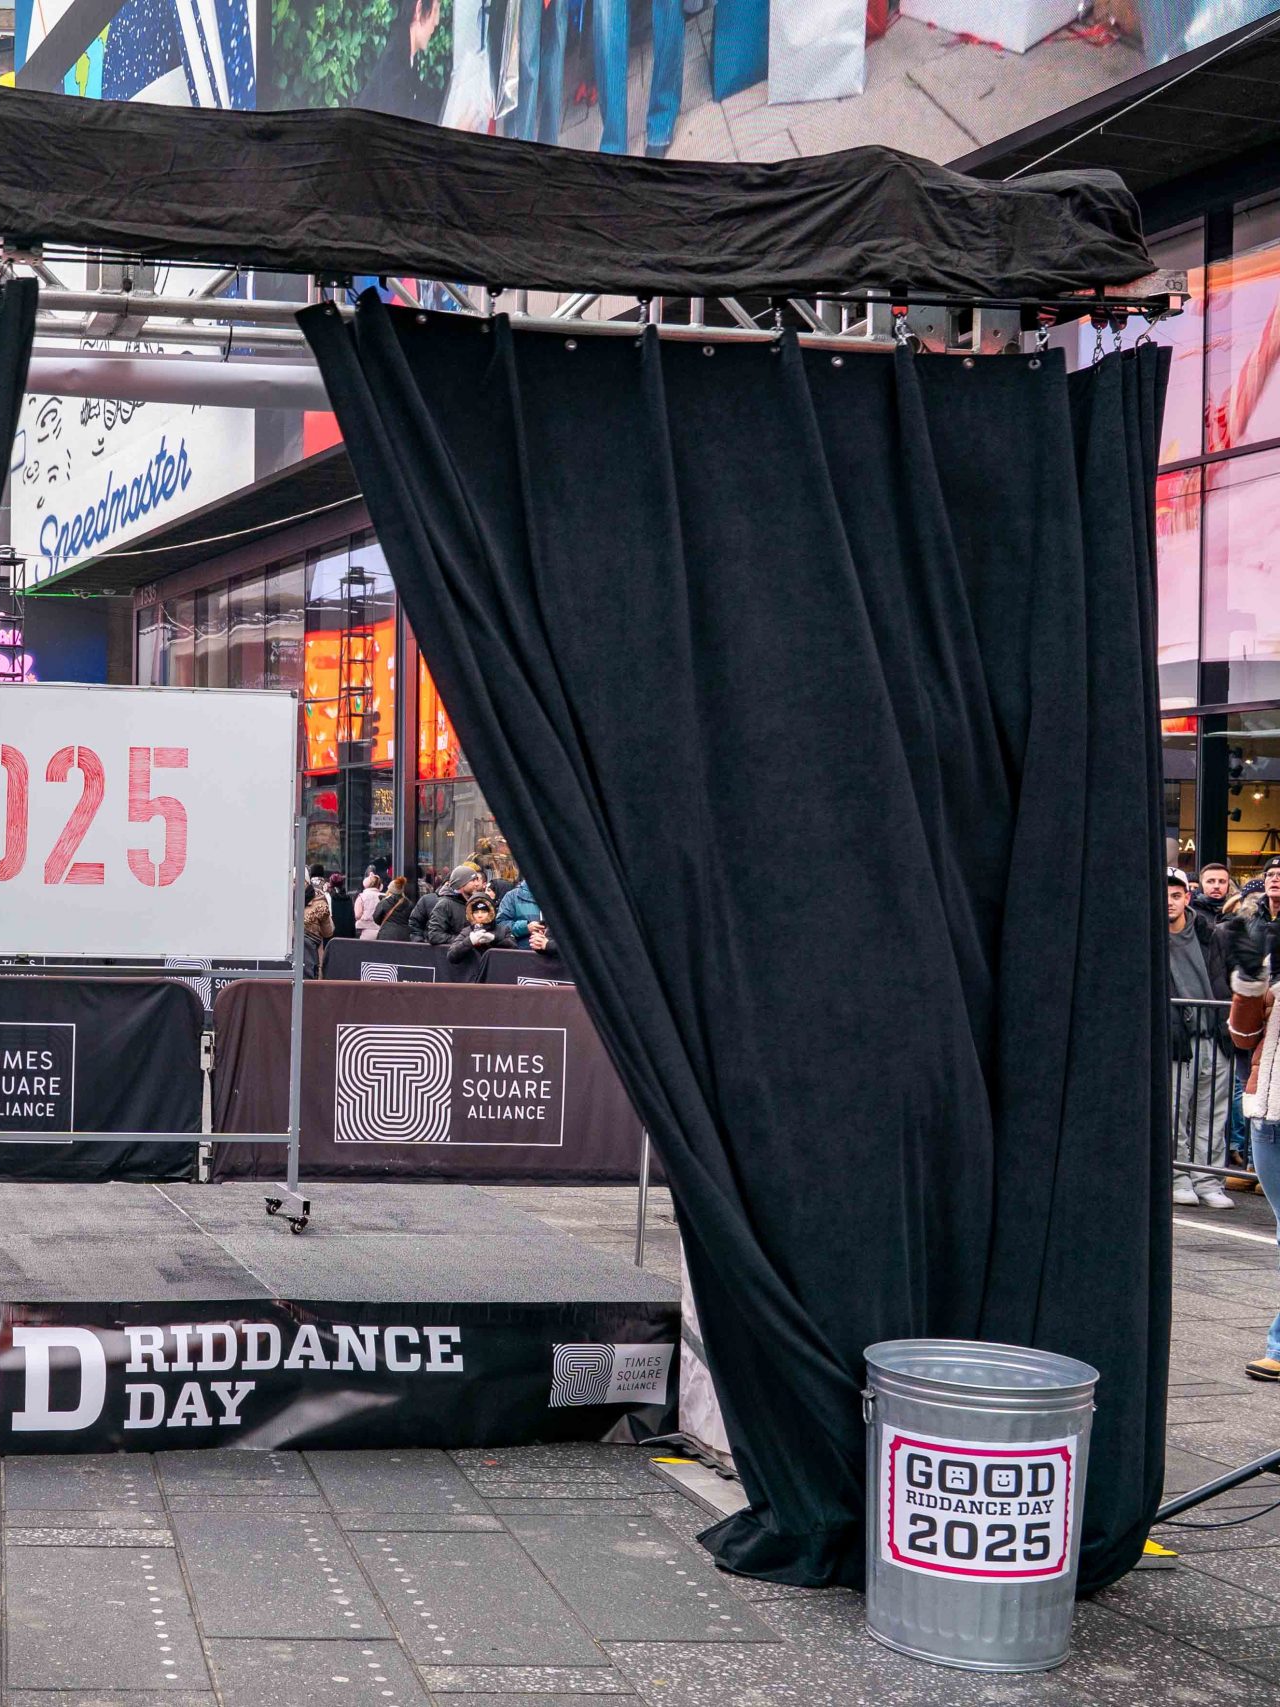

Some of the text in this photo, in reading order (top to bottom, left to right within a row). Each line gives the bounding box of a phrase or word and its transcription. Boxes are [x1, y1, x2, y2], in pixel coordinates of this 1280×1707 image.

[35, 435, 193, 583] Speedmaster
[471, 1054, 545, 1074] TIMES
[462, 1079, 552, 1099] SQUARE
[468, 1105, 546, 1121] ALLIANCE
[124, 1324, 464, 1373] RIDDANCE
[624, 1356, 662, 1368] TIMES
[616, 1368, 663, 1381] SQUARE
[616, 1381, 658, 1391] ALLIANCE
[124, 1381, 256, 1429] DAY
[906, 1452, 1056, 1498] GOOD
[905, 1489, 1055, 1516] RIDDANCE DAY
[908, 1513, 1051, 1562] 2025
